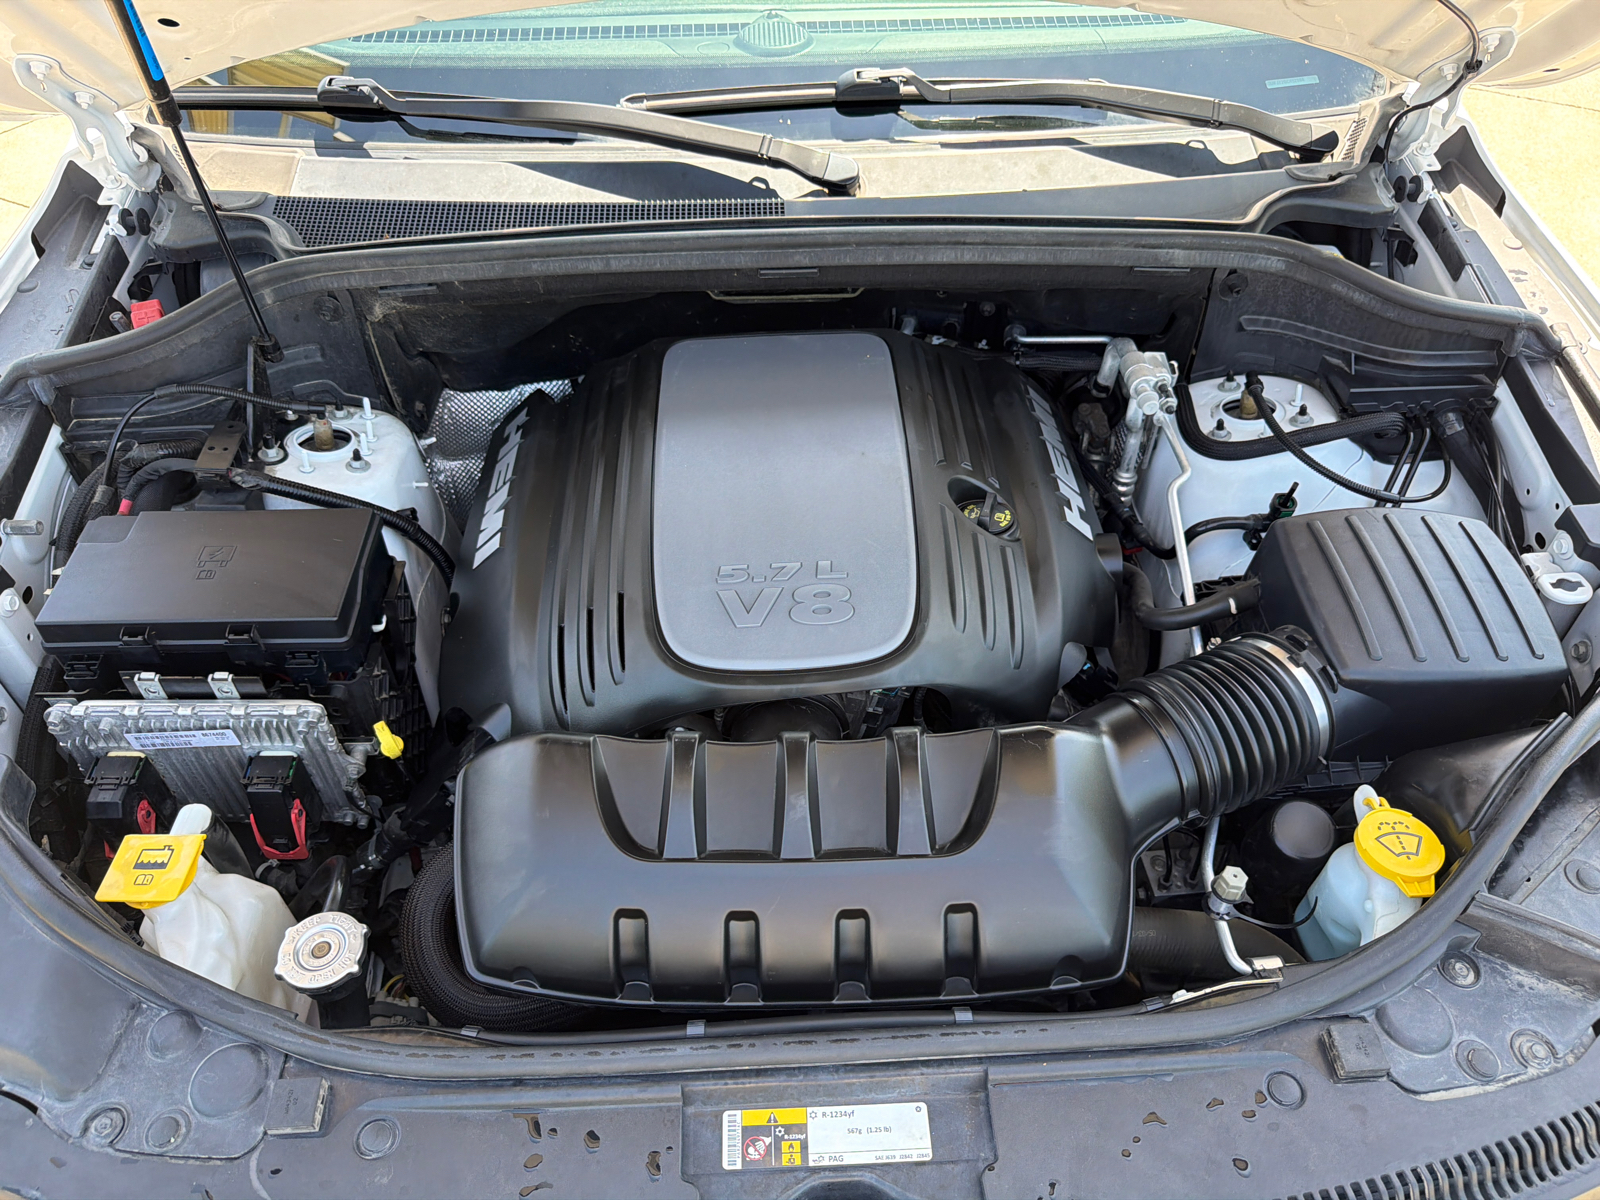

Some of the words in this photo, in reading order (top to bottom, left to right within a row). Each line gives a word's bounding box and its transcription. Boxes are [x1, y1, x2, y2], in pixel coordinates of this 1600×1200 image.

[1025, 384, 1094, 542] HEMI
[472, 406, 530, 570] HEMI
[716, 562, 803, 584] 5.7
[815, 560, 849, 579] L
[715, 582, 856, 629] V8
[293, 916, 322, 937] KEEP
[329, 914, 358, 934] TIGHT
[308, 968, 337, 983] OPEN
[821, 1109, 855, 1120] R-1234yf
[866, 1126, 883, 1135] (1.25
[883, 1126, 892, 1134] lb)
[828, 1154, 844, 1163] PAG
